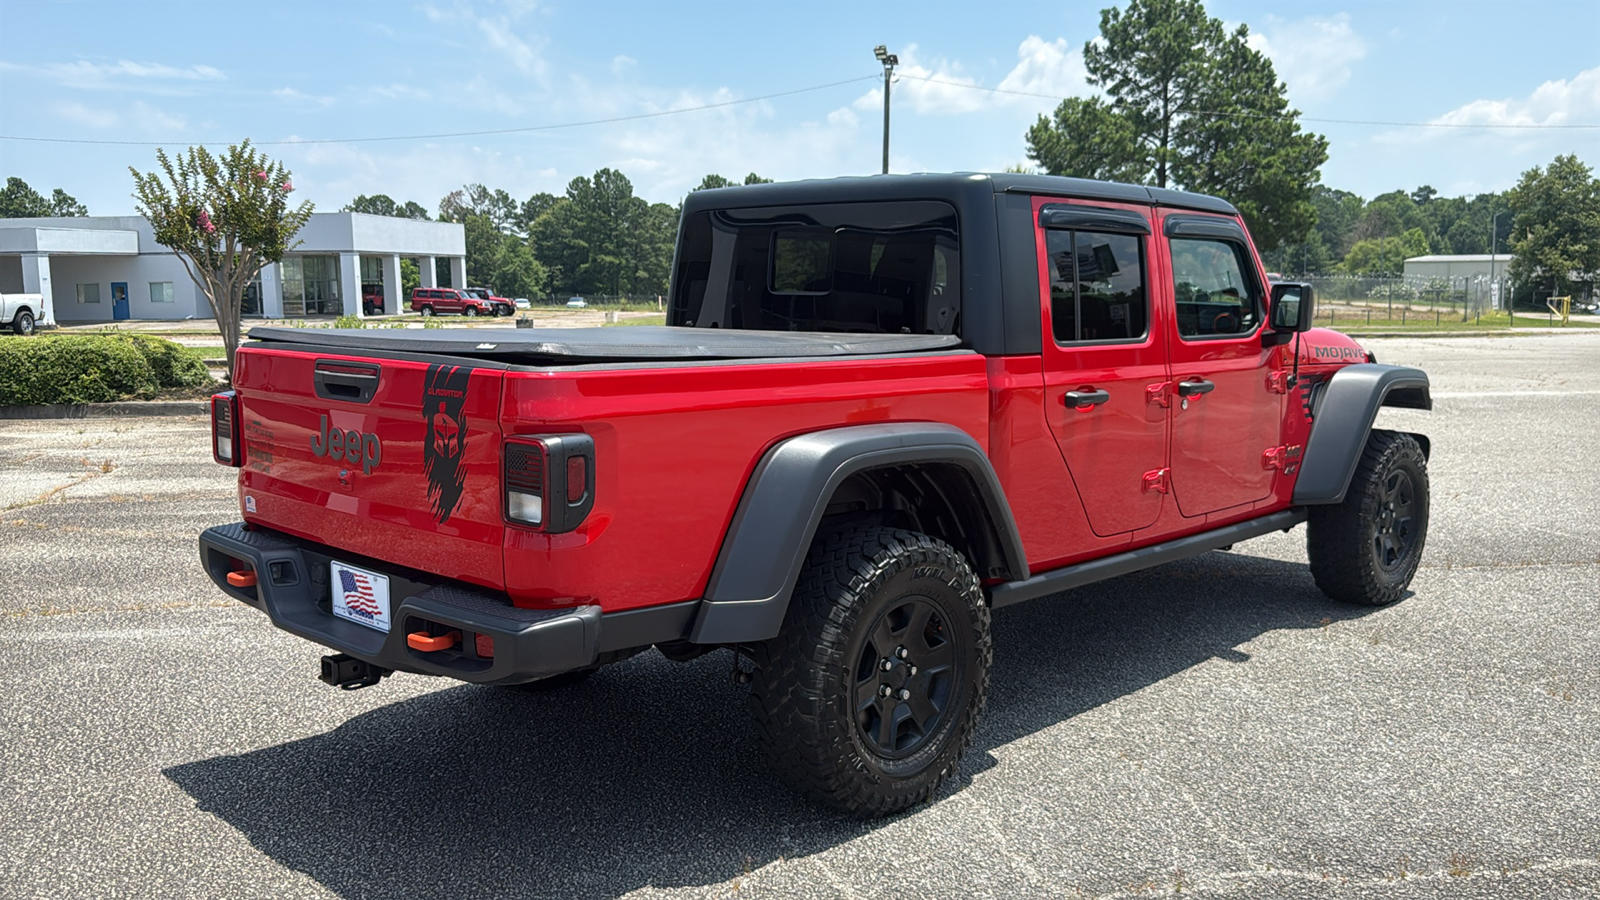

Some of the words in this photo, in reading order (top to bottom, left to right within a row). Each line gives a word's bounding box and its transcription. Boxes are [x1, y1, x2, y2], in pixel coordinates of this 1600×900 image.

[1314, 346, 1366, 359] MOJAVE
[427, 387, 463, 399] GLADIATOR
[310, 414, 382, 475] Jeep
